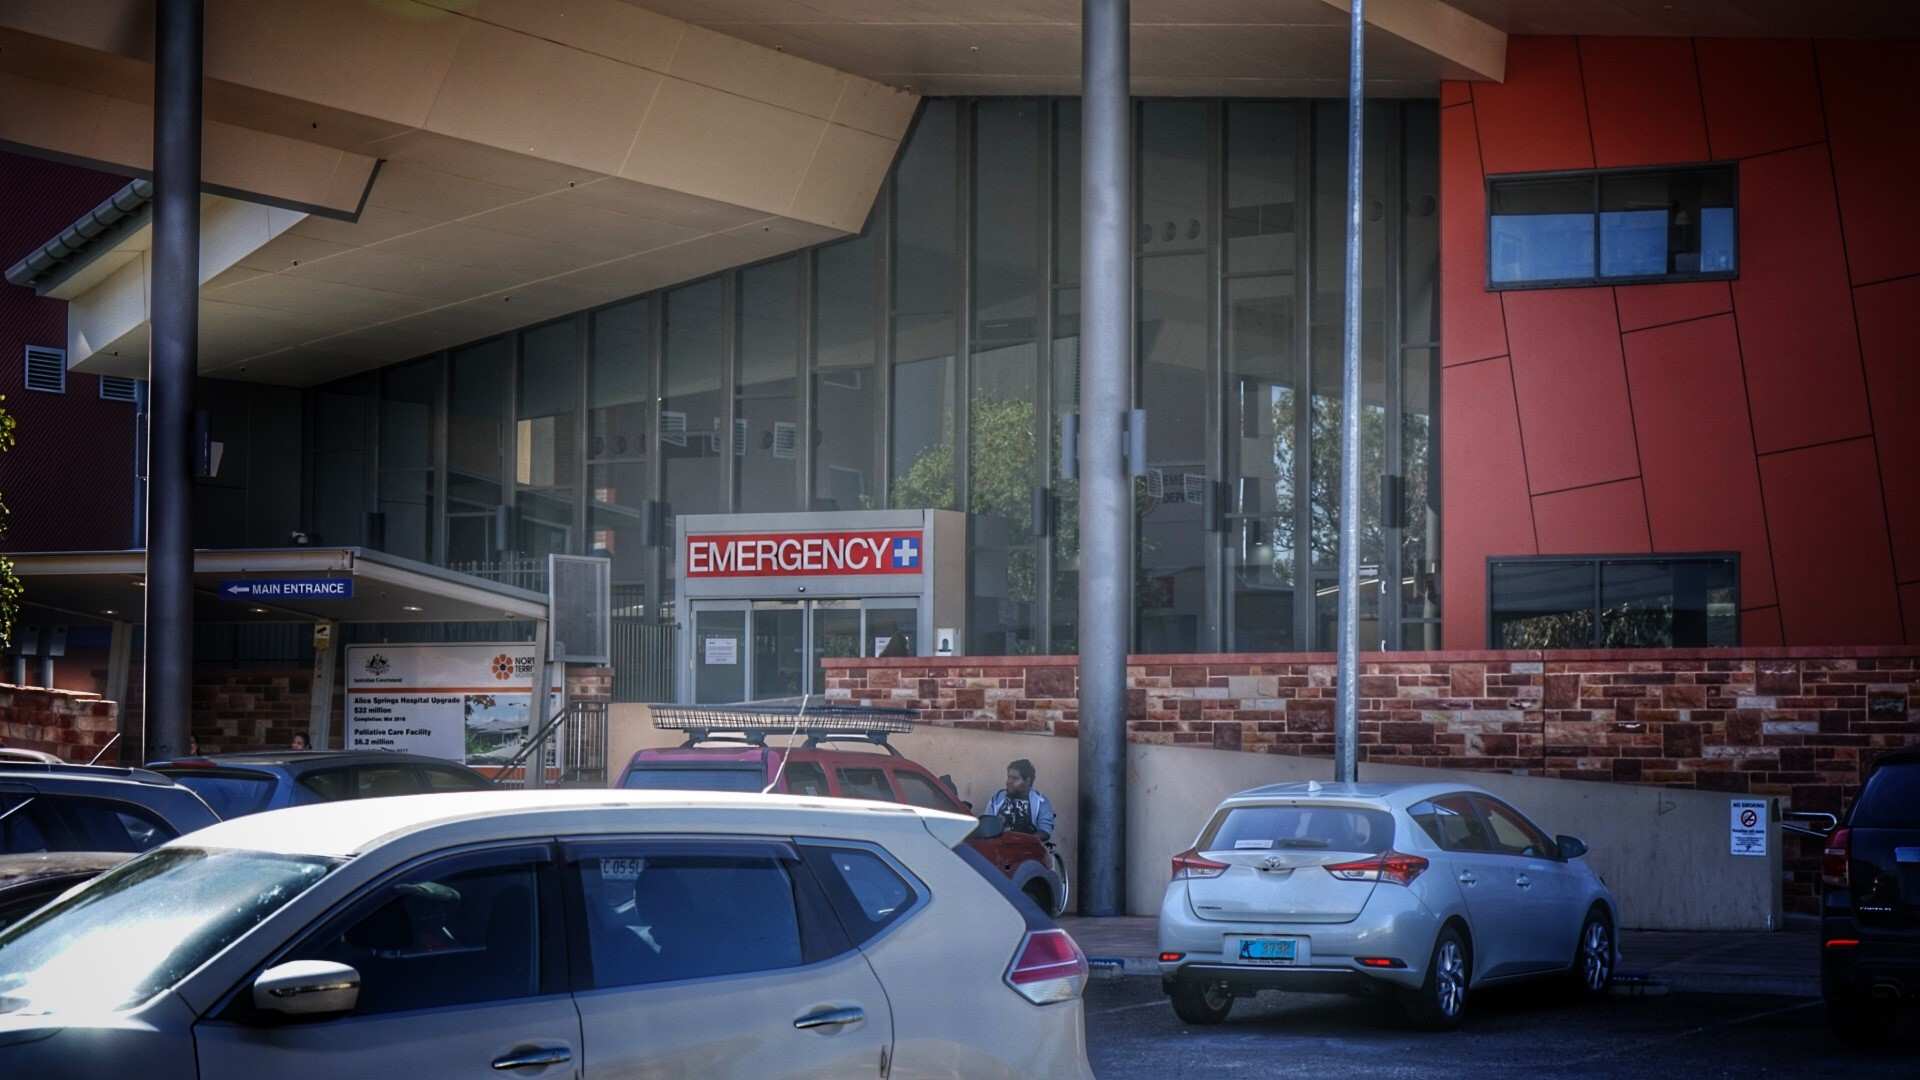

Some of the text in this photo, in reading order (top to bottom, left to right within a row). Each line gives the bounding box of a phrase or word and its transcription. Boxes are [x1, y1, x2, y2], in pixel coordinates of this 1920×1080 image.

[689, 537, 890, 573] EMERGENCY
[252, 583, 344, 595] MAIN ENTRANCE
[373, 697, 399, 705] Springs
[400, 697, 429, 705] Hospital
[431, 697, 460, 705] Upgrade
[354, 728, 431, 737] Palliative Care Facility
